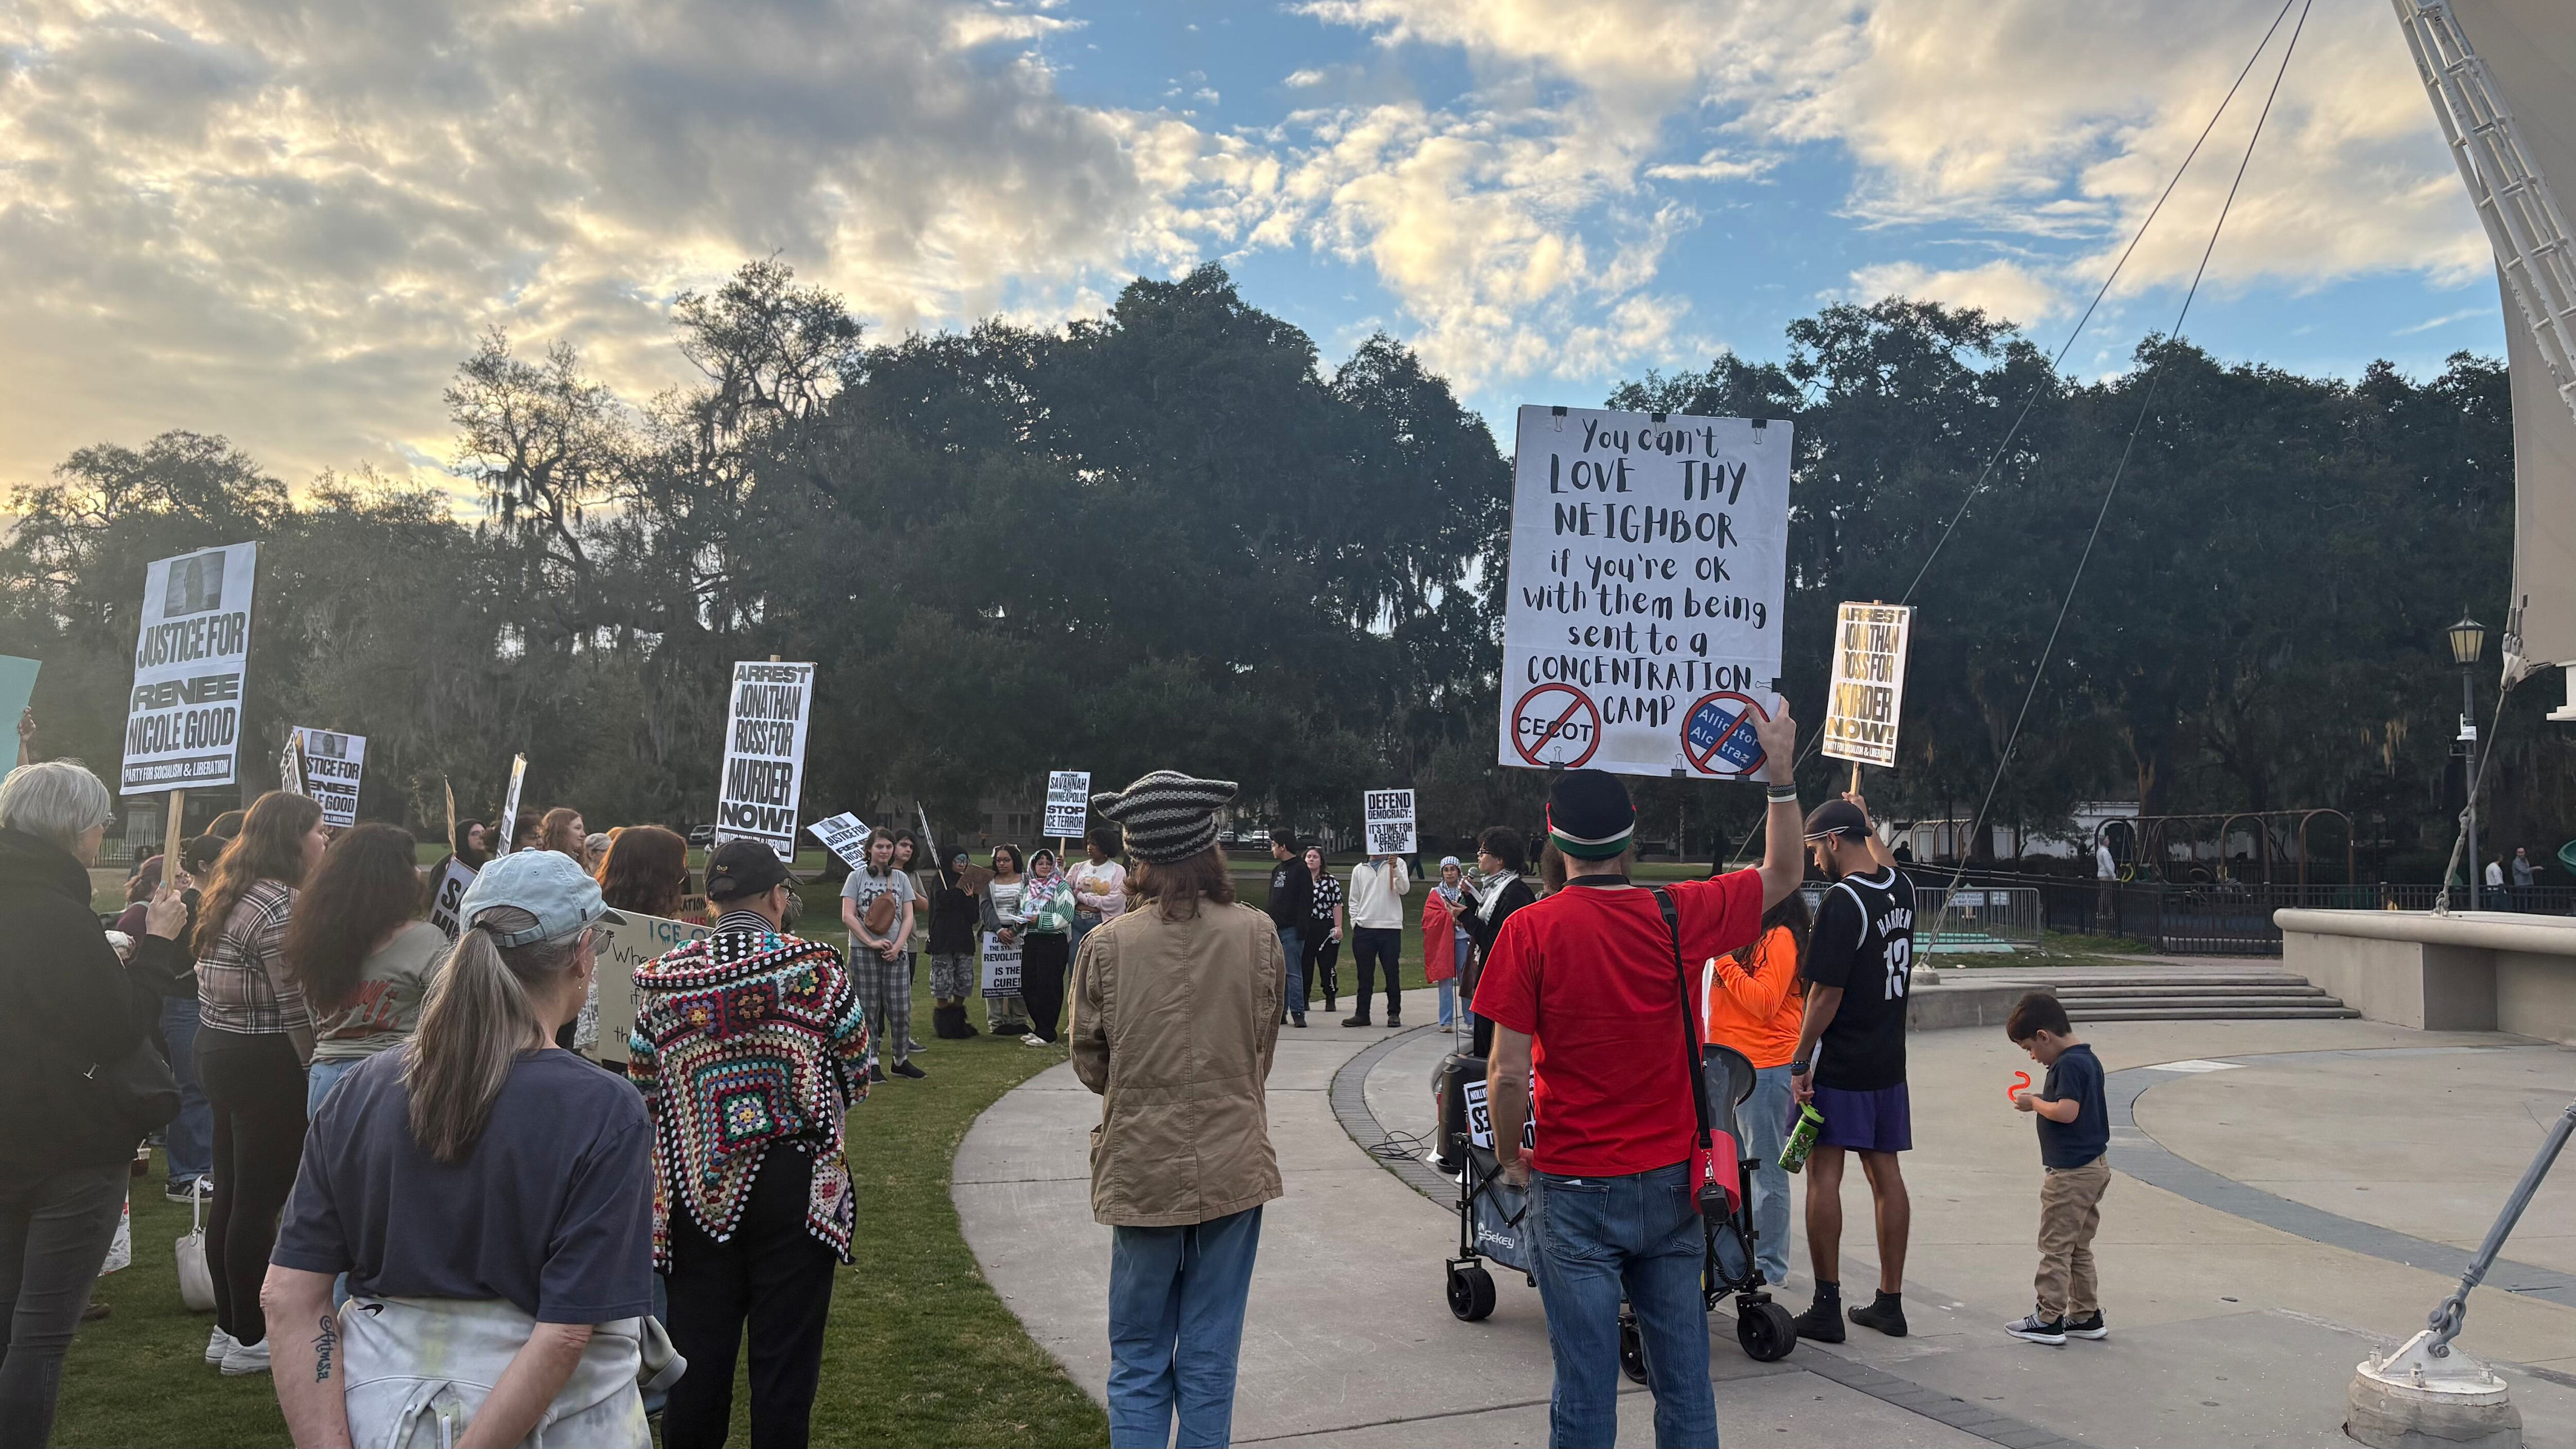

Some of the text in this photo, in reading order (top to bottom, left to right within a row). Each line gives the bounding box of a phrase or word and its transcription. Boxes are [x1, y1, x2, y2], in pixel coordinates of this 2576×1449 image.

[1583, 418, 1719, 457] You can't
[1550, 453, 1746, 505] LOVE THY
[1555, 502, 1737, 548] NEIGHBOR
[1552, 548, 1570, 577] if
[1585, 554, 1677, 590] you're
[1523, 581, 1766, 629] with them being
[1841, 608, 1906, 624] ARREST
[138, 611, 246, 669] JUSTICE FOR
[1568, 621, 1706, 656] sent to a
[1841, 623, 1900, 654] JONATHAN
[735, 665, 811, 683] ARREST
[1528, 655, 1750, 692] CONCENTRATION
[1842, 651, 1894, 682] ROSS FOR
[133, 673, 240, 712] RENEE
[735, 684, 802, 720] JONATHAN
[1833, 682, 1893, 723] MURDER
[1604, 695, 1675, 727] CAMP
[127, 706, 236, 755] NICOLE GOOD
[735, 719, 794, 757] ROSS FOR
[1518, 717, 1593, 741] CECOT
[1827, 717, 1895, 745] NOW!
[1691, 726, 1750, 763] Alctraz
[1864, 747, 1869, 756] &
[125, 759, 229, 782] PARTY FOR SOCIALISM & LIBERATION
[305, 757, 360, 780] STICE FOR
[309, 780, 357, 795] ENEE
[726, 758, 793, 807] MURDER
[1050, 777, 1086, 790] SAVANNAH
[325, 795, 355, 813] GOOD
[1047, 805, 1085, 814] STOP
[1049, 791, 1086, 803] MINNEAPOLIS
[1368, 793, 1410, 809] DEFEND
[720, 802, 795, 834] NOW!
[1046, 815, 1084, 828] ICE TERROR
[1368, 809, 1411, 819] DEMOCRACY:
[825, 825, 870, 845] JUSTICE FOR
[1369, 823, 1412, 834] IT'S TIME FOR
[1374, 832, 1409, 843] A GENERAL
[1379, 843, 1405, 852] STRIKE!
[649, 920, 681, 947] ICE
[1877, 908, 1912, 938] HARDEN
[984, 952, 1022, 961] REVOLUTI
[1883, 938, 1909, 1000] 13
[994, 978, 1020, 987] CURE!
[995, 966, 1020, 975] IS THE
[1485, 1230, 1514, 1249] Sekey
